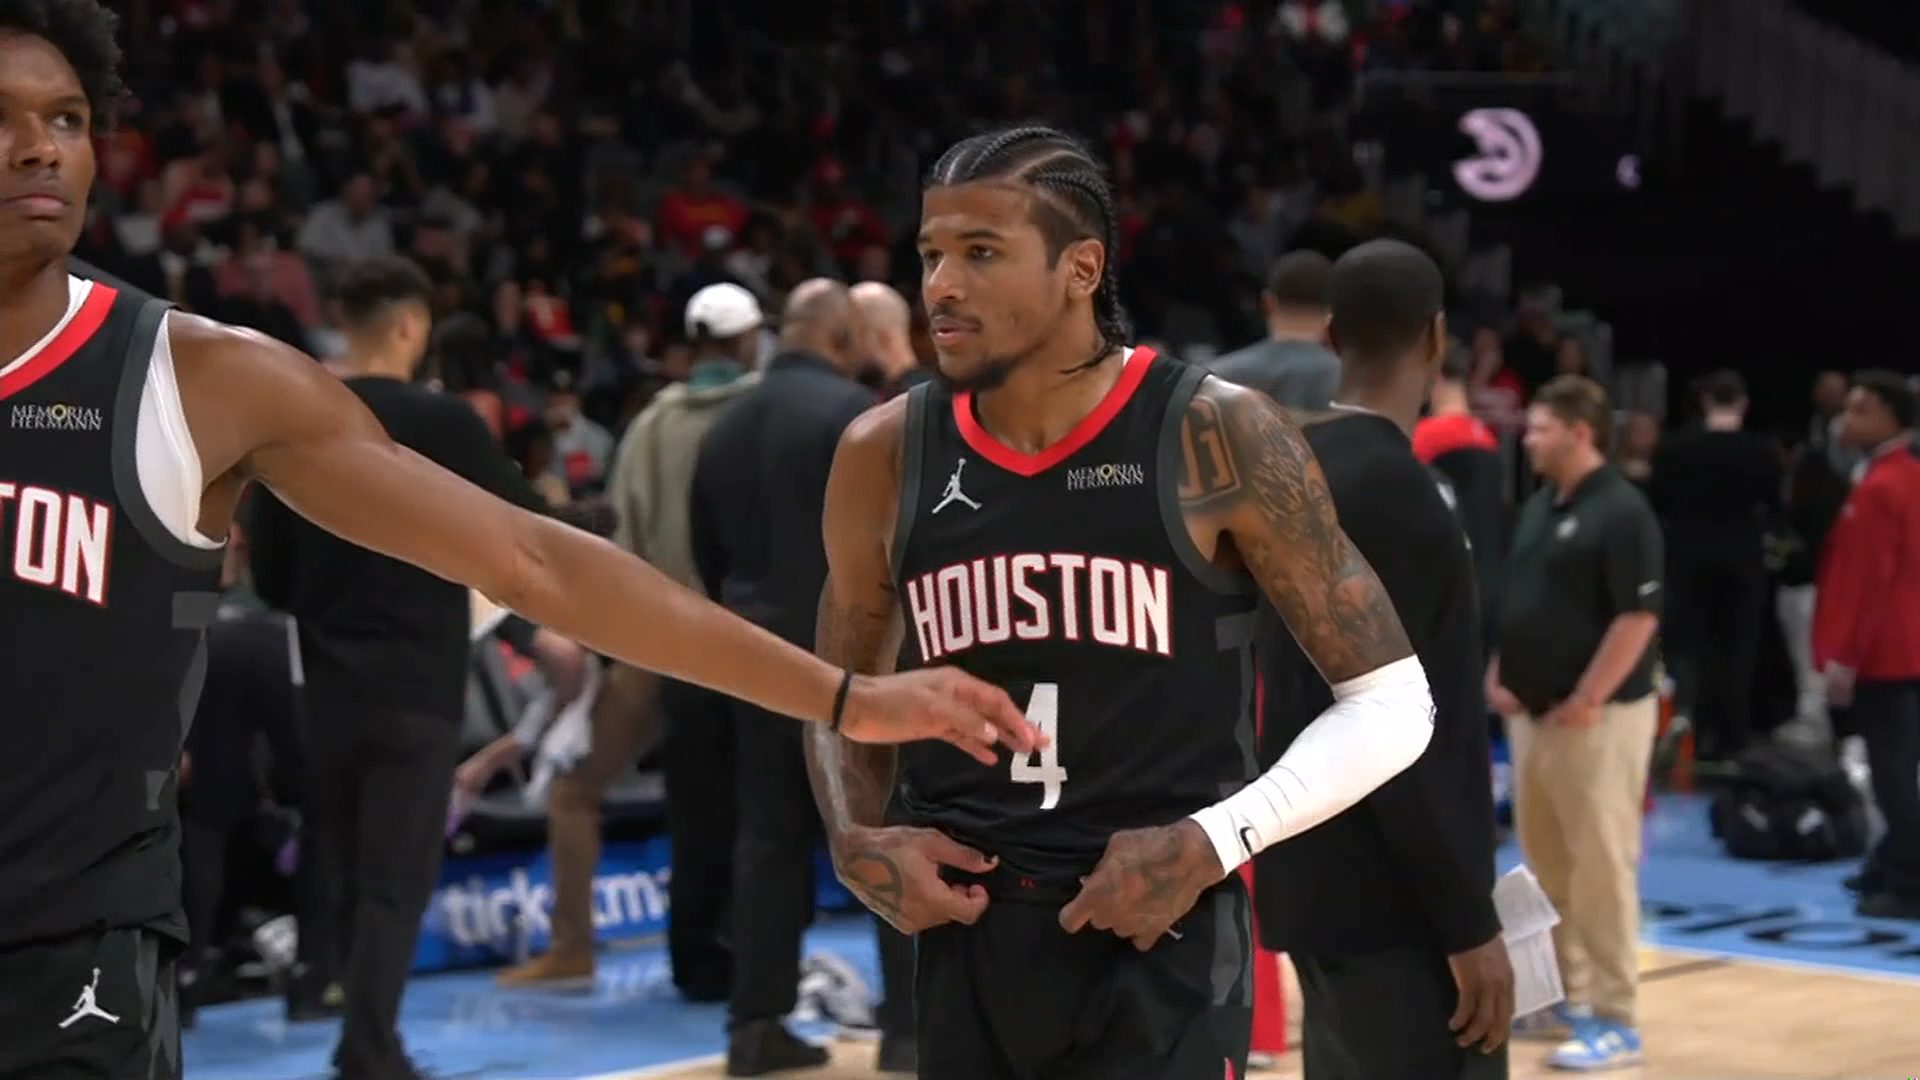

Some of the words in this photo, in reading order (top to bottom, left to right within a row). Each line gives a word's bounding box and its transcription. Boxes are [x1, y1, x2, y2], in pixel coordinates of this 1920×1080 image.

[12, 404, 102, 420] MEMORIAL
[11, 415, 102, 430] HERMANN
[1067, 463, 1143, 481] MEMORIAL
[1067, 471, 1144, 490] HERMANN
[907, 552, 1171, 662] HOUSTON
[1010, 682, 1068, 810] 4
